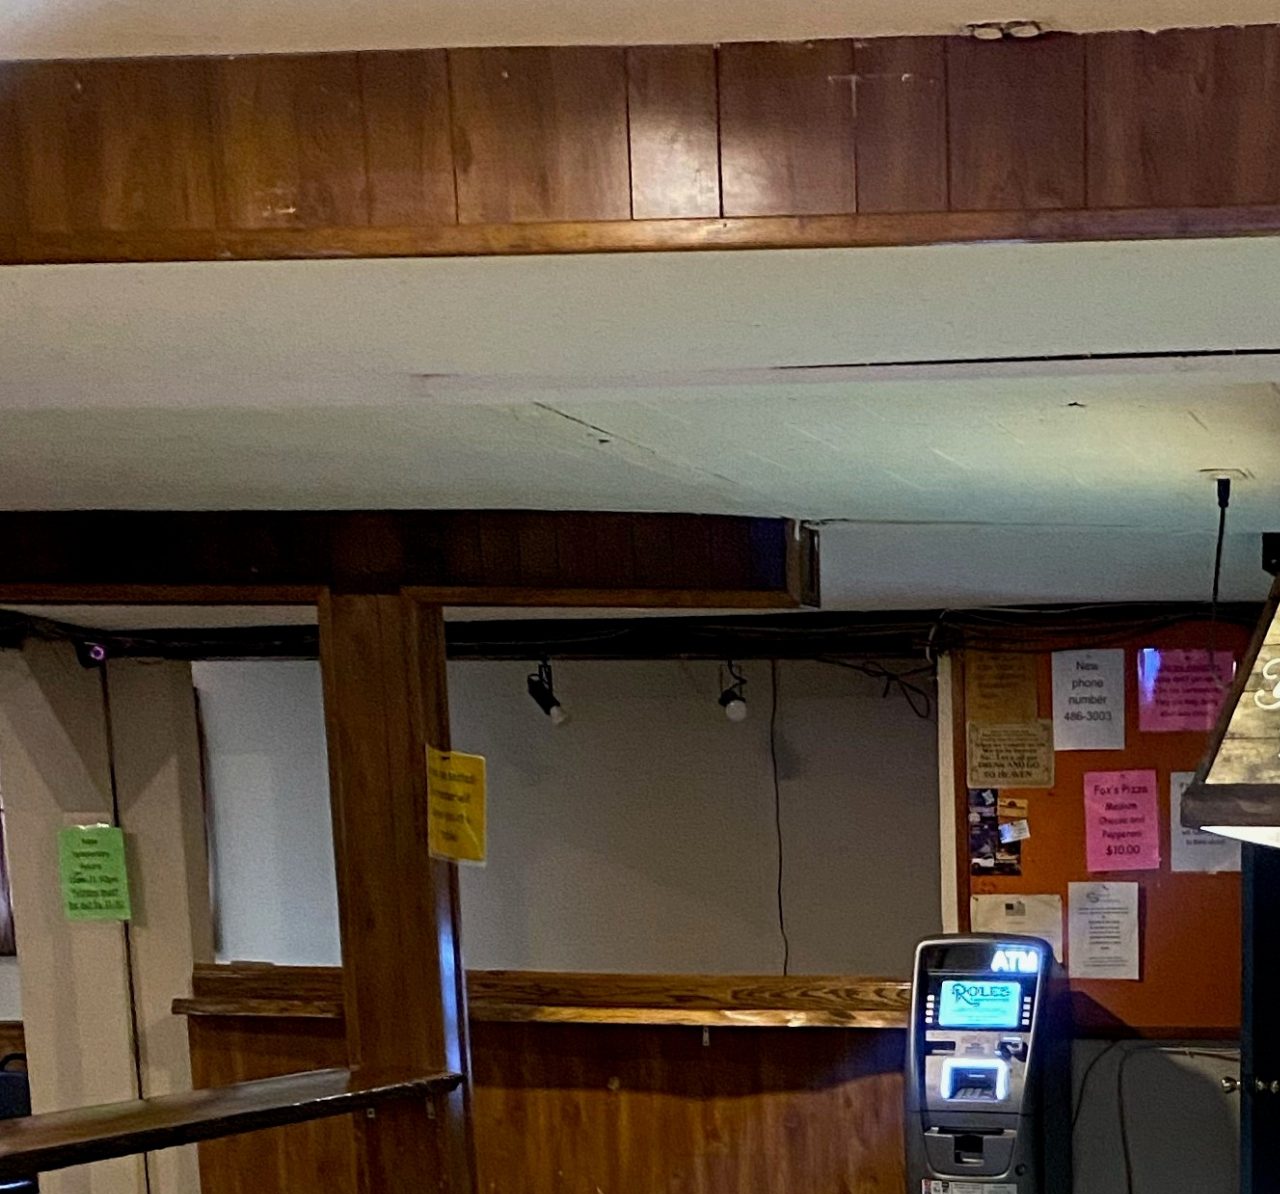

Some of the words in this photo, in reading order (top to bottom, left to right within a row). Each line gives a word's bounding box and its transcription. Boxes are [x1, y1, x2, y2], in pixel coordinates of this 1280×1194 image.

[1071, 678, 1104, 690] phone
[1068, 694, 1108, 705] number
[1093, 784, 1119, 795] Fox's
[1121, 783, 1148, 794] Pizza
[1105, 844, 1141, 856] $10.00
[990, 950, 1038, 974] ATM
